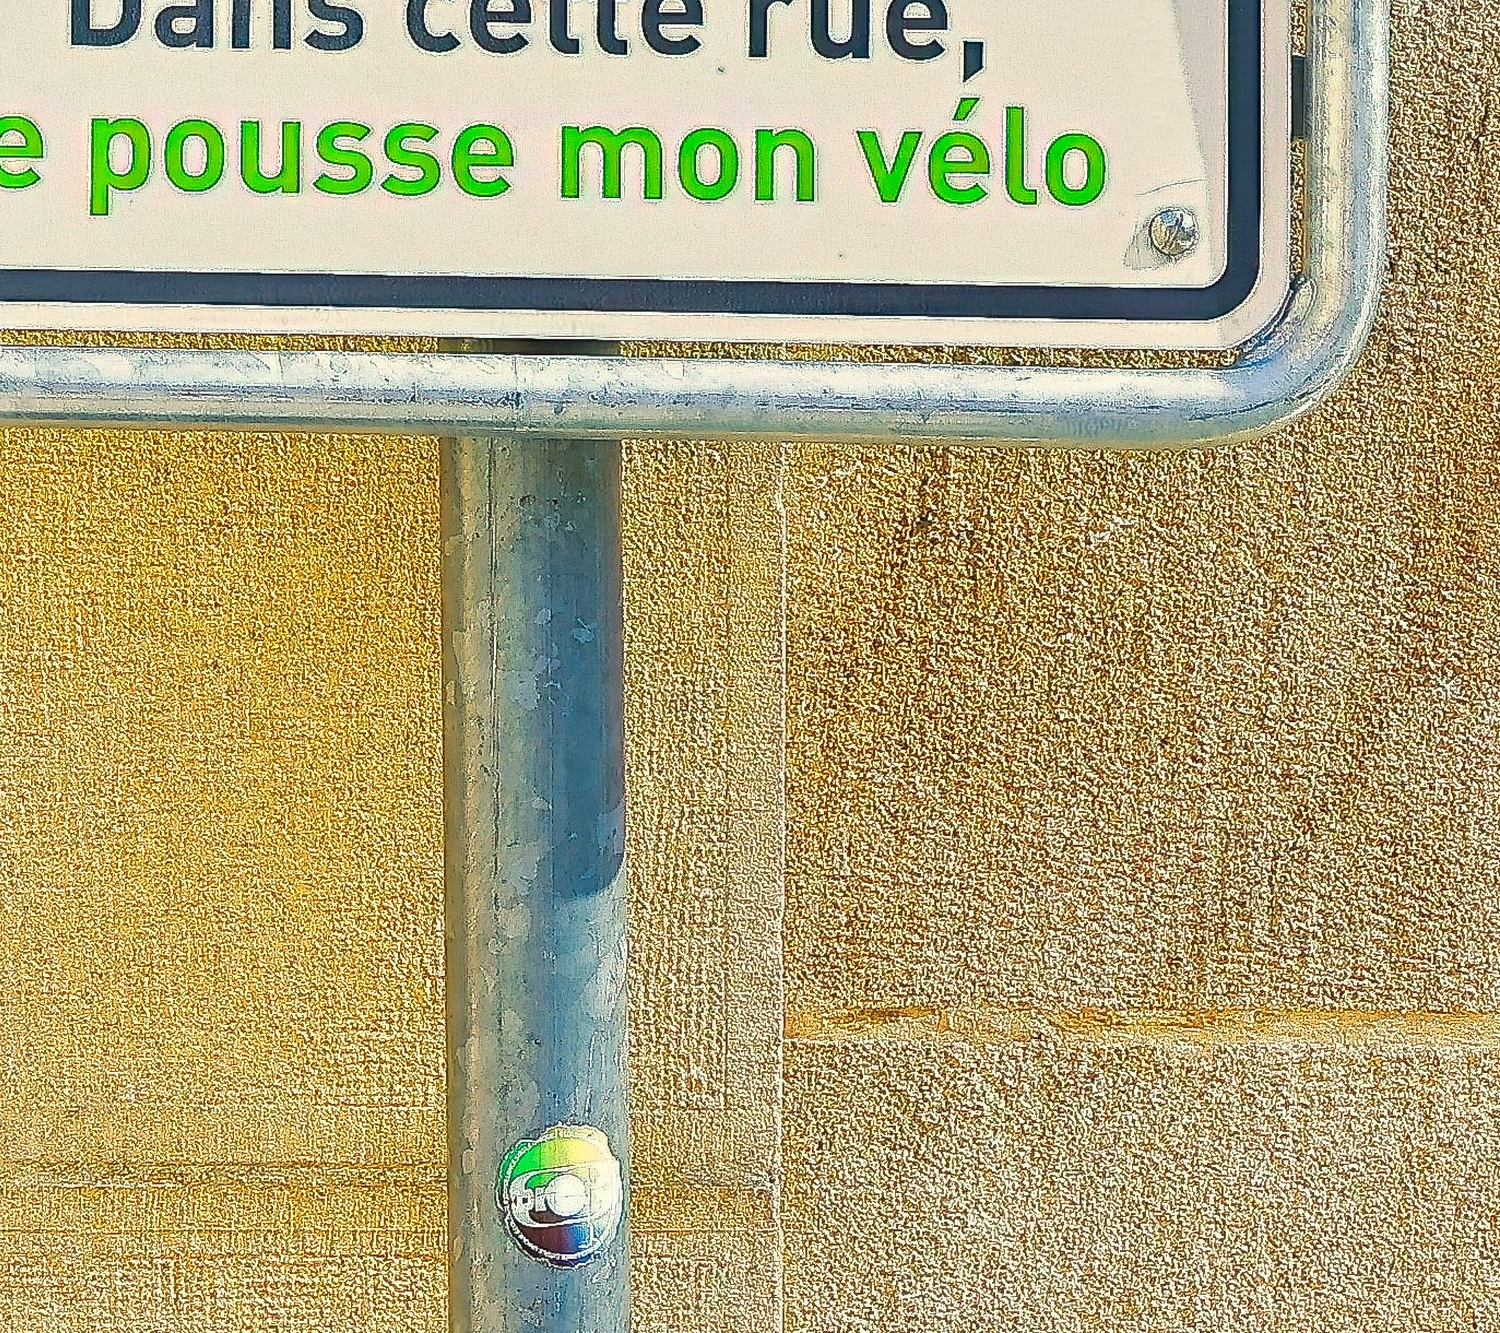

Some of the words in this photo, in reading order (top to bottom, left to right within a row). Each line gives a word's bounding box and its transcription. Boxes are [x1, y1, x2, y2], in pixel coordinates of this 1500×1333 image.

[89, 117, 516, 217] pousse
[560, 124, 816, 203] mon
[857, 96, 1107, 206] vélo
